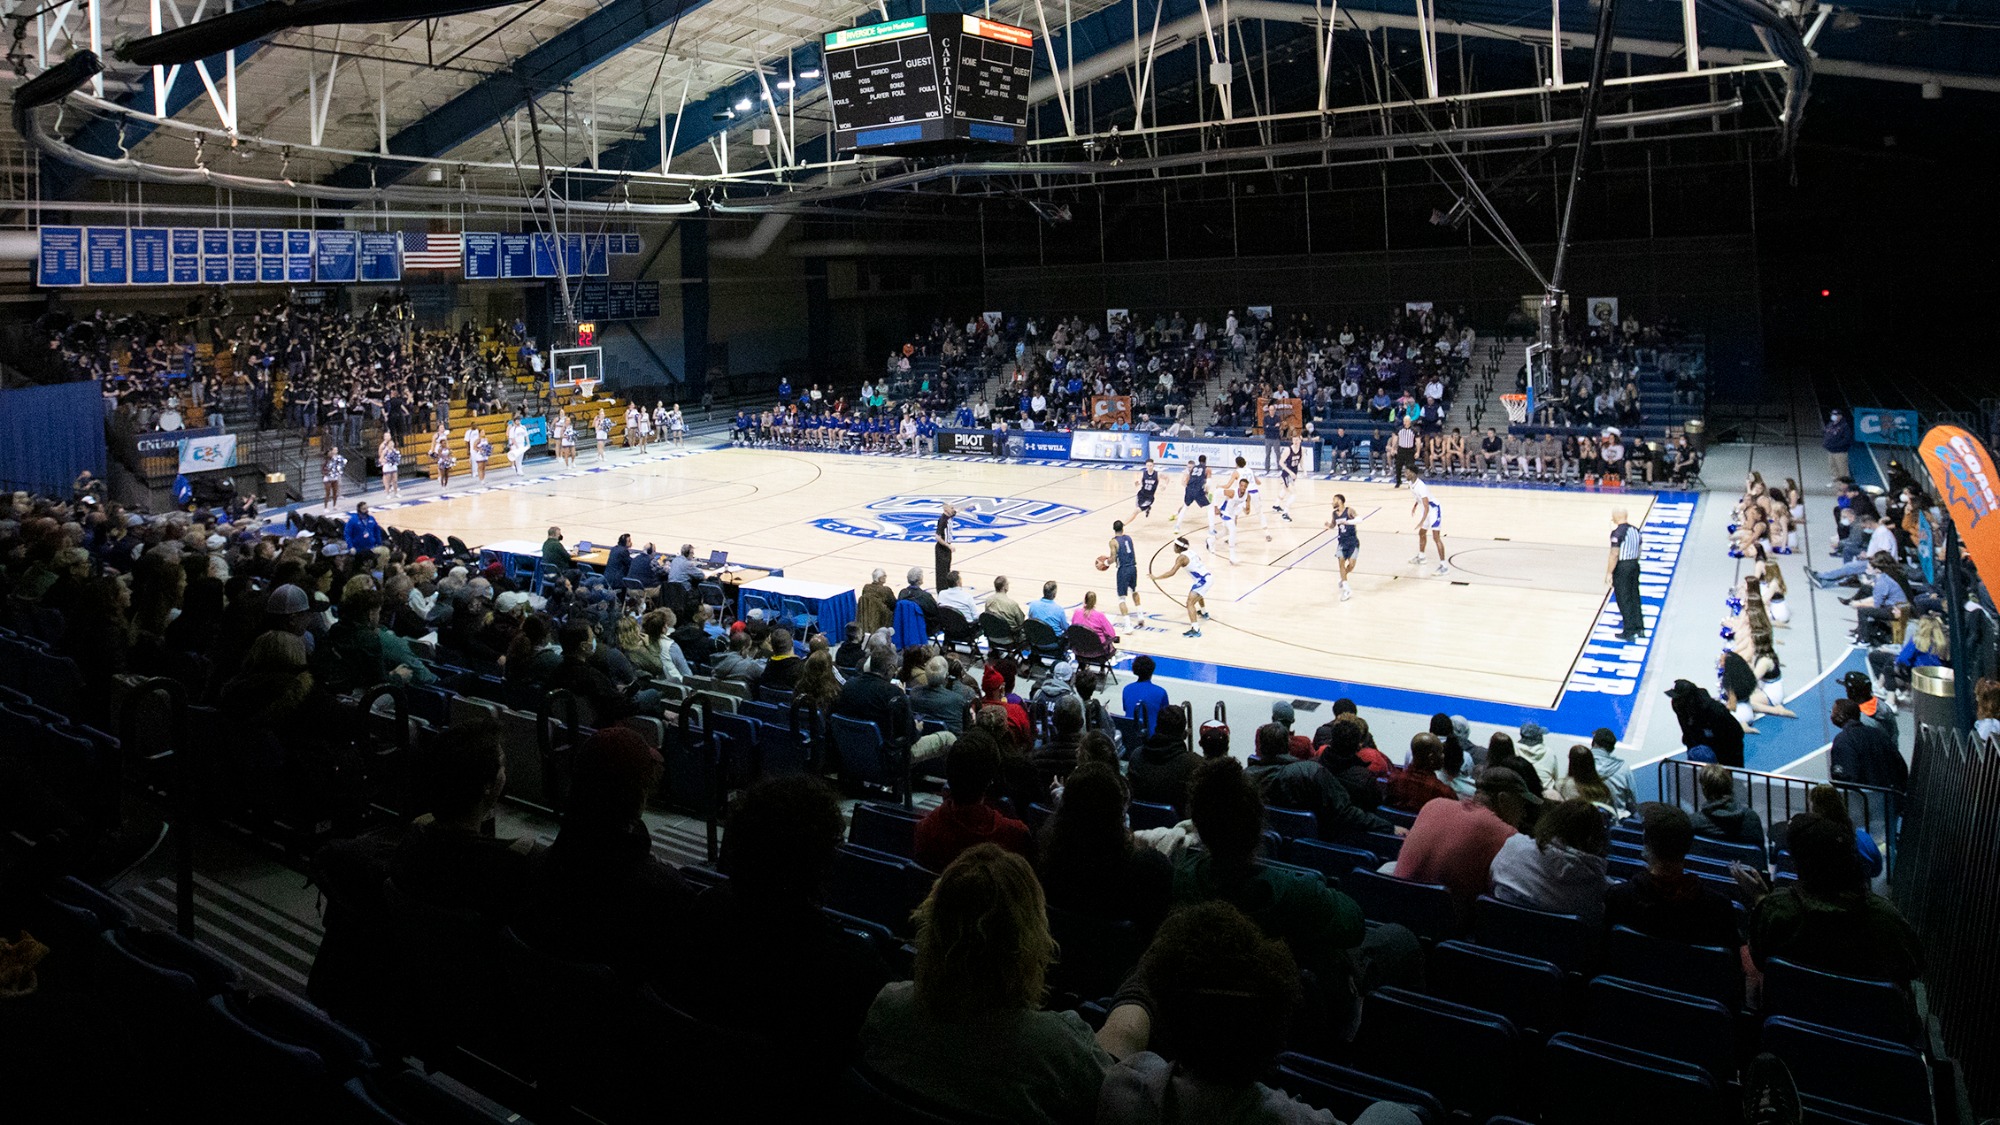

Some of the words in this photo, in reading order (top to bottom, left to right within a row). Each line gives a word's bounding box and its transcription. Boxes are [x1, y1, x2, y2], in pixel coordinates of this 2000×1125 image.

[846, 27, 876, 40] RIVERSIDE
[905, 56, 932, 68] GUEST
[962, 56, 977, 67] HOME
[832, 70, 852, 80] HOME
[871, 68, 889, 76] PERIOD
[942, 37, 952, 115] CAPTAINS
[1013, 66, 1030, 77] GUEST
[859, 86, 875, 94] BONUS
[889, 81, 905, 90] BONUS
[918, 85, 936, 93] FOULS
[957, 84, 970, 92] FOULS
[869, 91, 890, 100] PLAYER
[891, 89, 906, 97] FOUL
[985, 88, 999, 97] PLAYER
[833, 98, 849, 106] FOULS
[889, 115, 905, 123] GAME
[925, 110, 939, 118] WON
[1950, 436, 1997, 510] COAST
[1648, 502, 1694, 525] THE
[1124, 540, 1131, 553] 1
